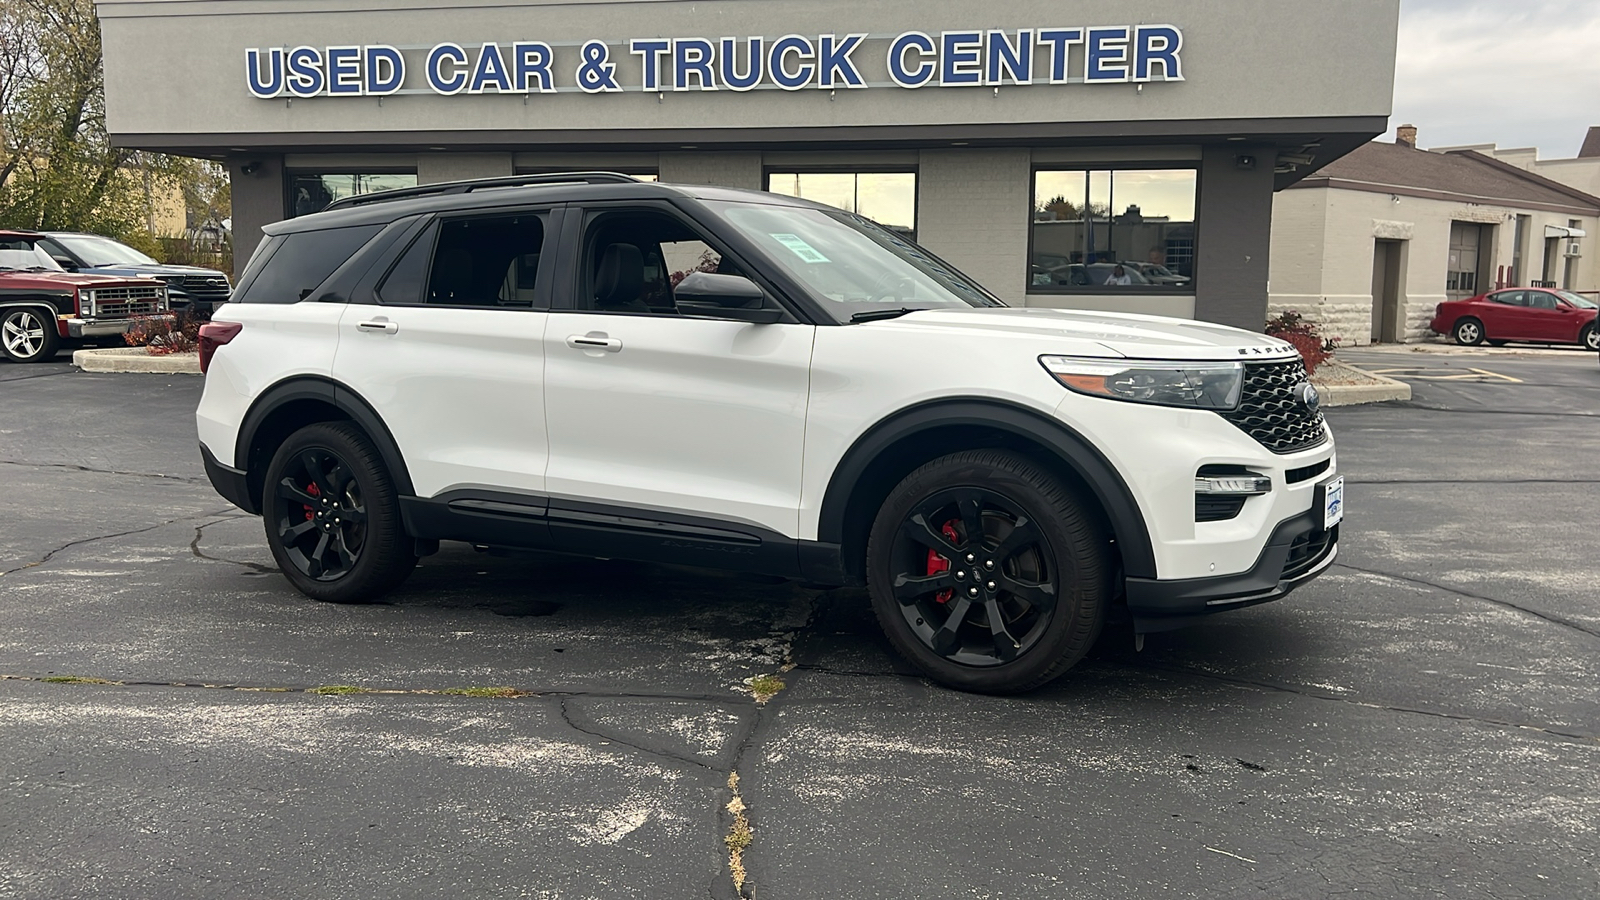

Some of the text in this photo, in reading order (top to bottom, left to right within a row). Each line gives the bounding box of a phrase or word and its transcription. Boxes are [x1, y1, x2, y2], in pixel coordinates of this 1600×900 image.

[245, 24, 1185, 99] USED CAR & TRUCK CENTER
